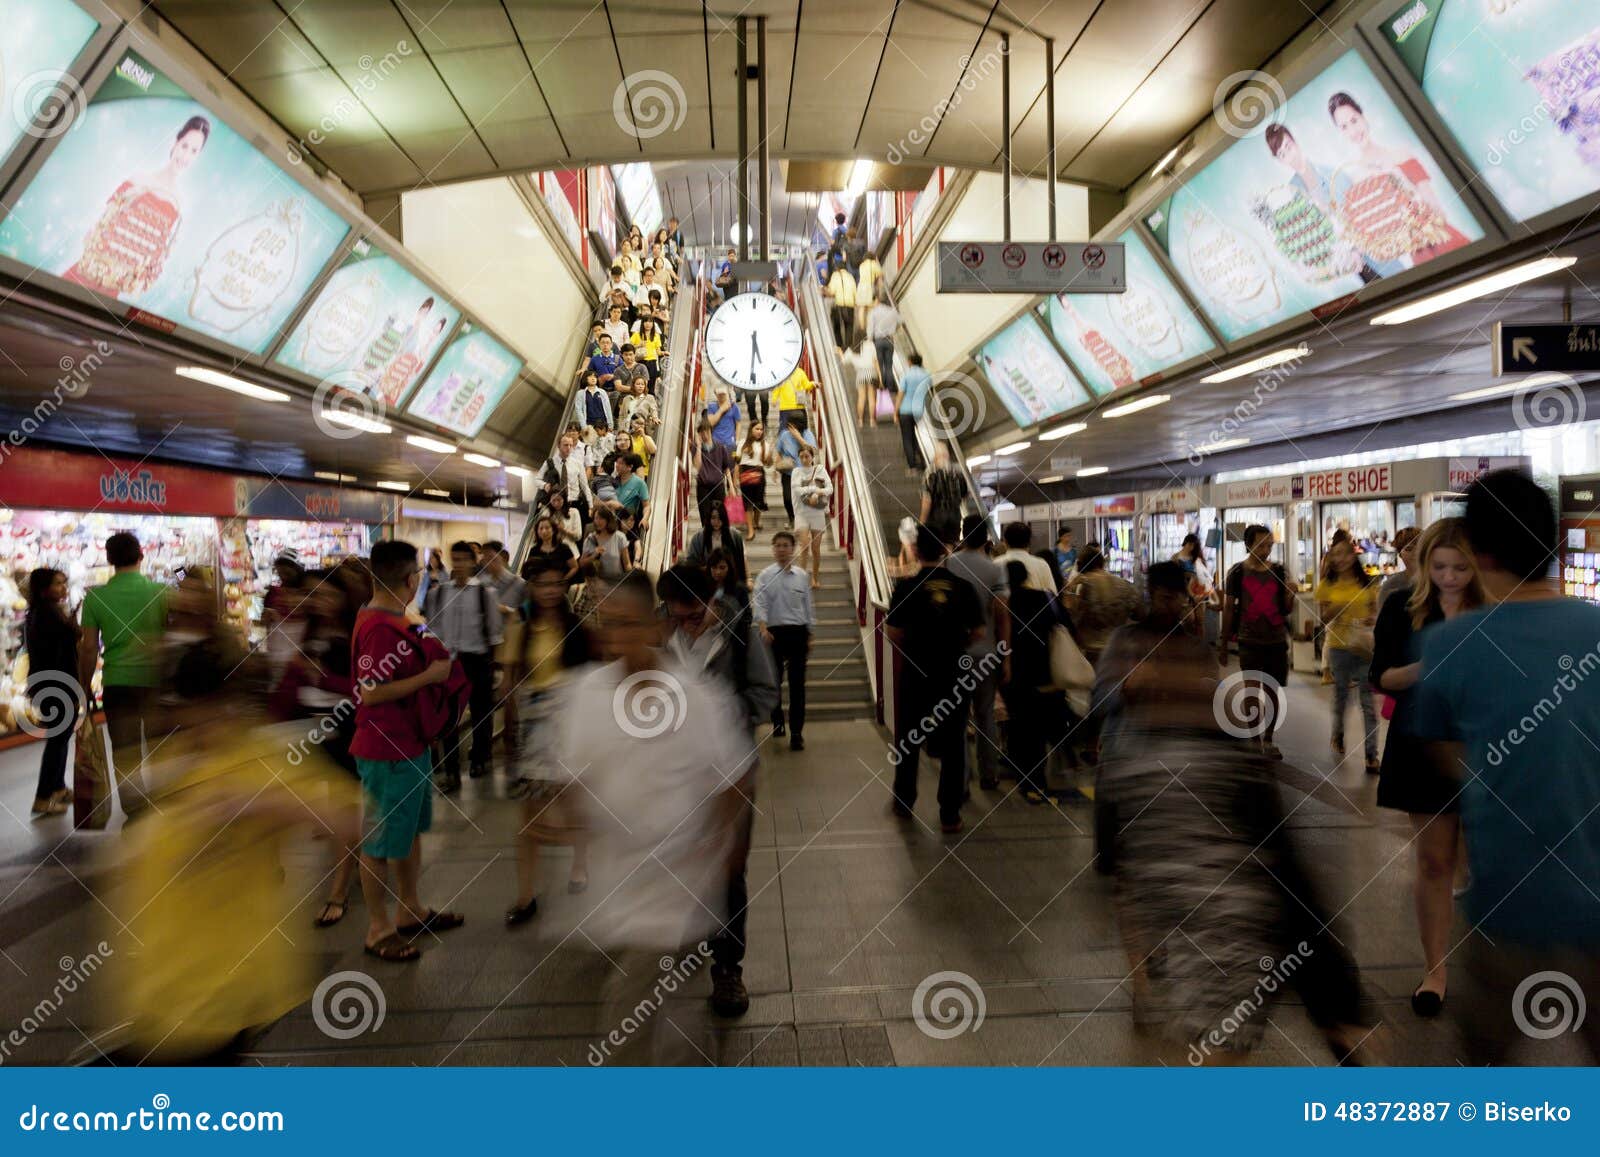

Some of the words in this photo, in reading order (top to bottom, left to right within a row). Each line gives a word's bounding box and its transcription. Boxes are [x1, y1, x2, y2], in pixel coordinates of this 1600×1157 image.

[1567, 326, 1600, 352] ขึ้นไ
[1309, 472, 1343, 497] FREE
[1347, 468, 1389, 494] SHOE
